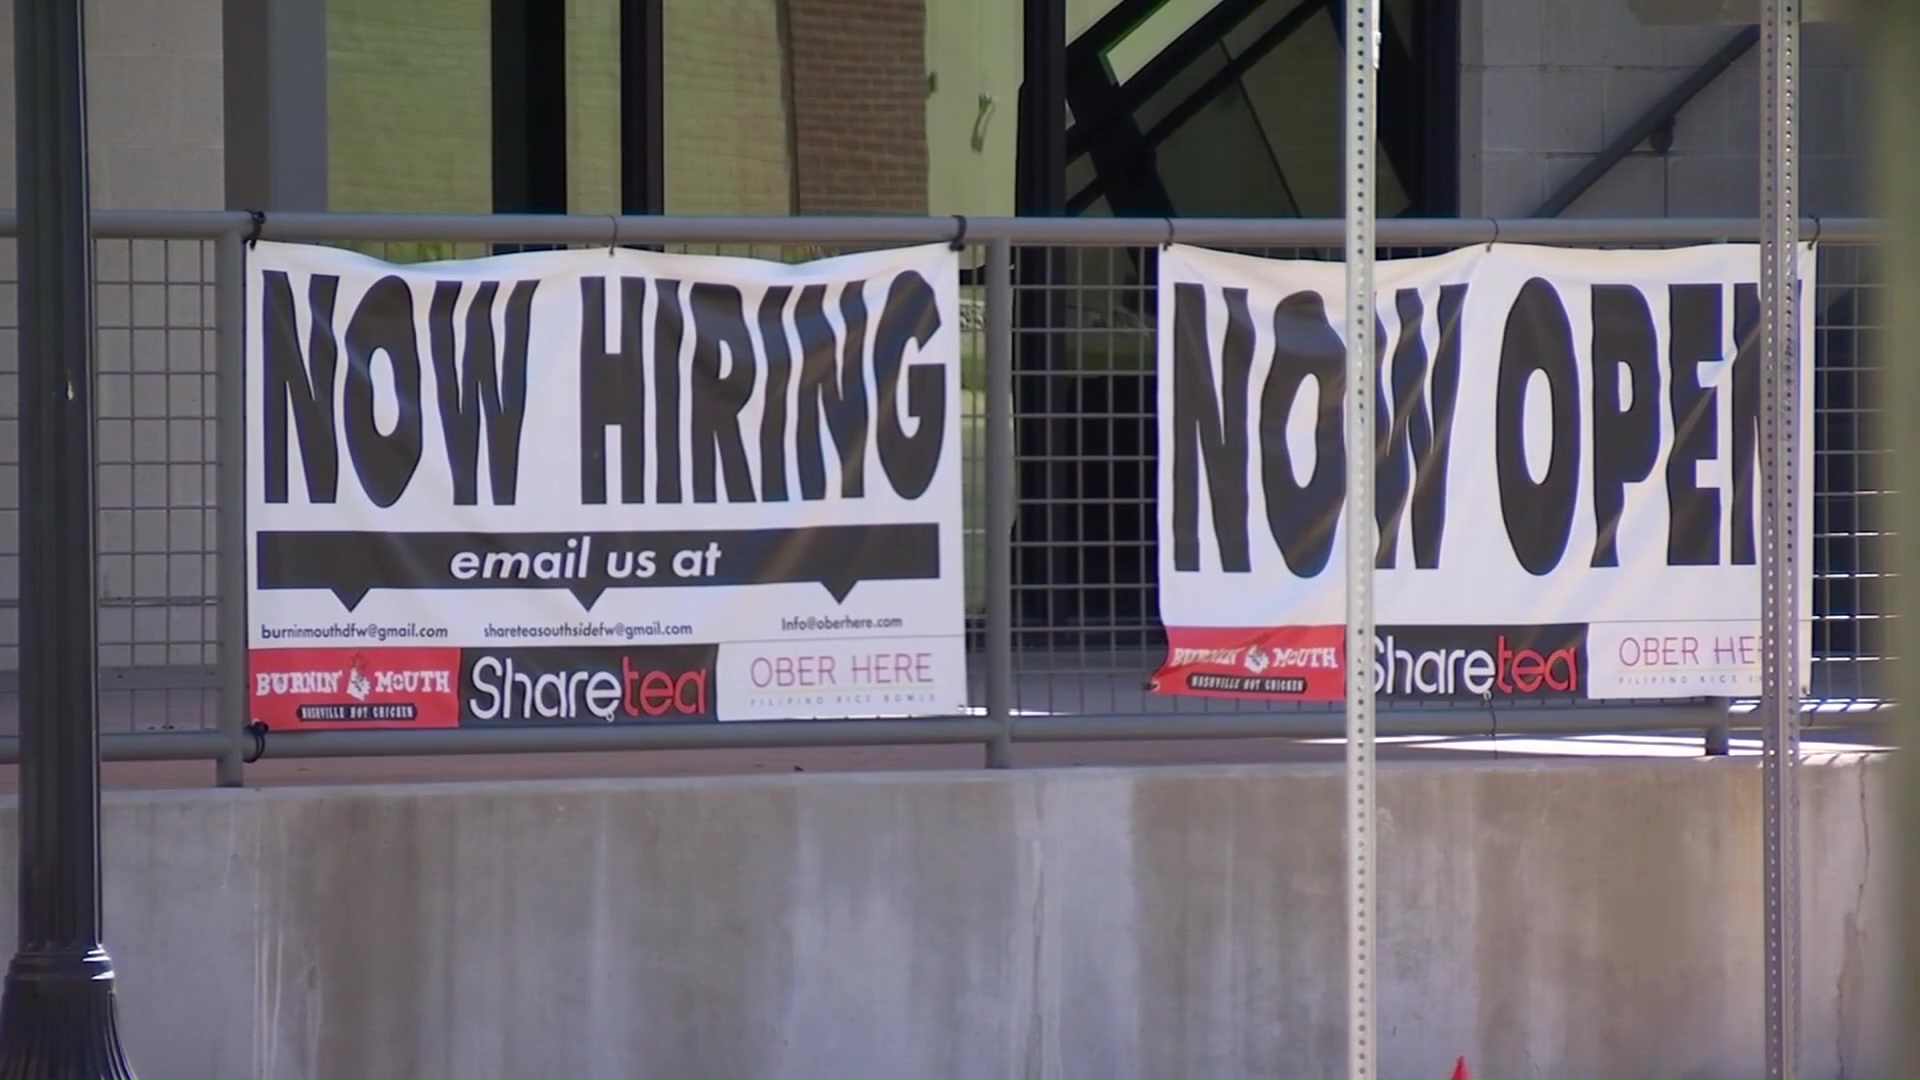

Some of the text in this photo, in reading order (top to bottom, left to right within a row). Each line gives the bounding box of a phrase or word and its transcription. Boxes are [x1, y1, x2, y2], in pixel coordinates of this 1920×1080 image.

[262, 269, 946, 508] NOW HIRING
[1172, 282, 1470, 579] NOW
[450, 536, 722, 580] email us at
[261, 623, 449, 641] burninmouthdfw@gmail.com
[483, 621, 693, 640] shareteasouthsidefw@gmail.com
[781, 615, 903, 631] Info@oberhere.com
[1272, 647, 1339, 669] MOUTH
[1619, 636, 1763, 667] OBER HE
[374, 671, 451, 693] MOUTH
[751, 653, 934, 688] OBER HERE
[469, 655, 707, 722] Sharetea
[1243, 679, 1261, 691] HOT
[1264, 680, 1304, 692] CHICKEN
